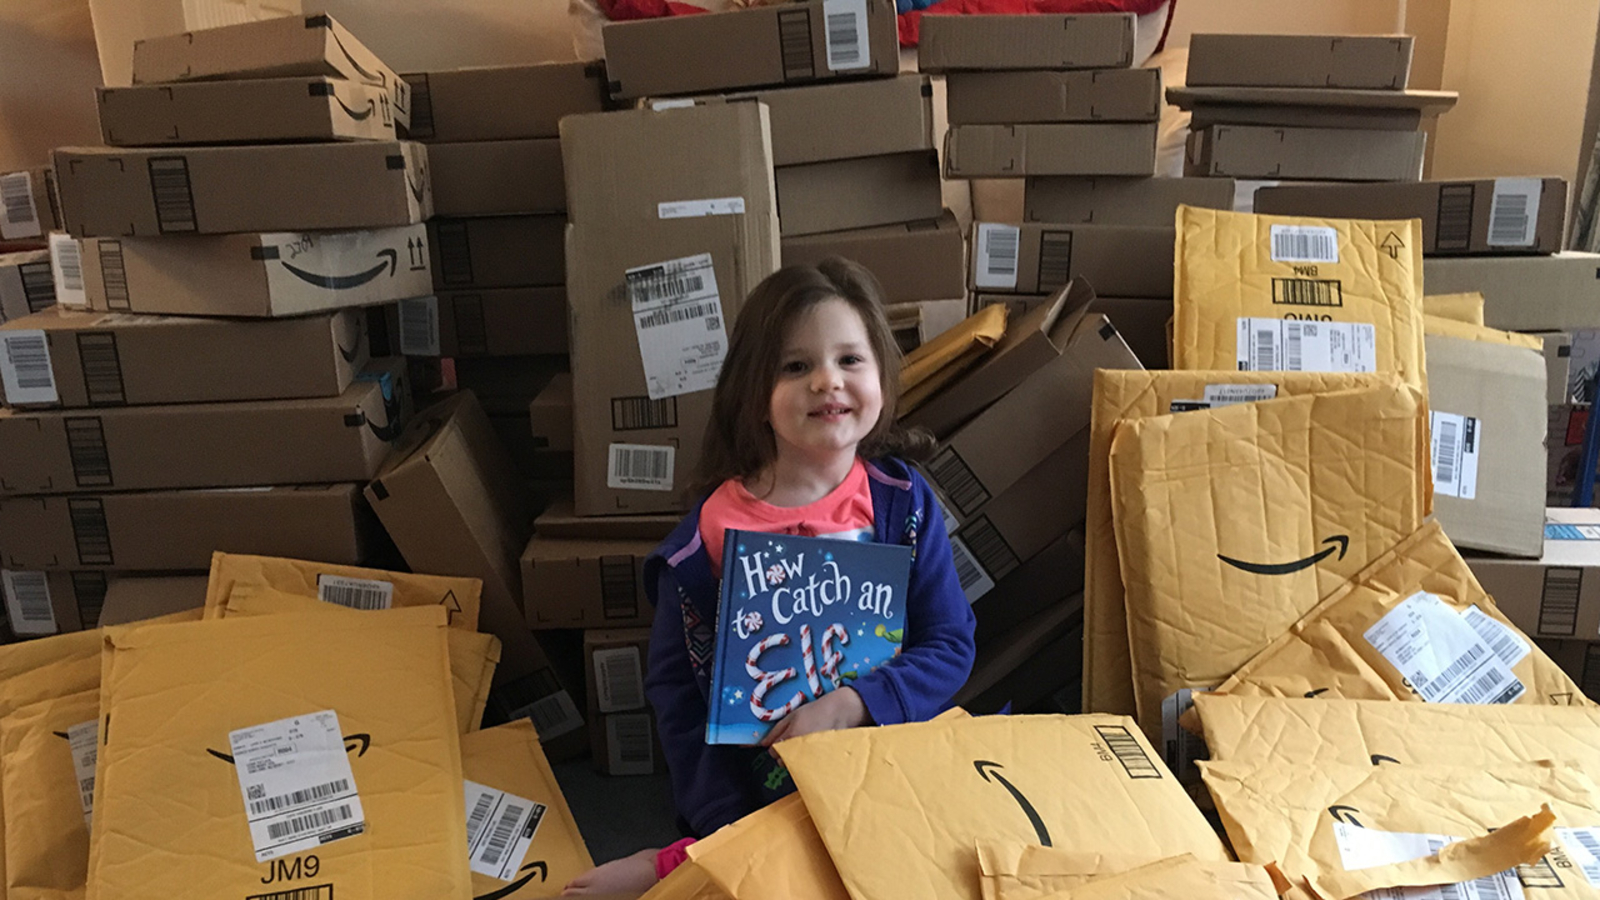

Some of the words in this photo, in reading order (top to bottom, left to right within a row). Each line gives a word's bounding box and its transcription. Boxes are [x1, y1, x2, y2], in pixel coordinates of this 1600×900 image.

[1293, 265, 1319, 277] BM4
[739, 551, 804, 600] How
[732, 606, 763, 640] to
[771, 561, 851, 625] Catch
[858, 581, 893, 619] an
[745, 623, 850, 722] Elf
[261, 855, 320, 884] JM9
